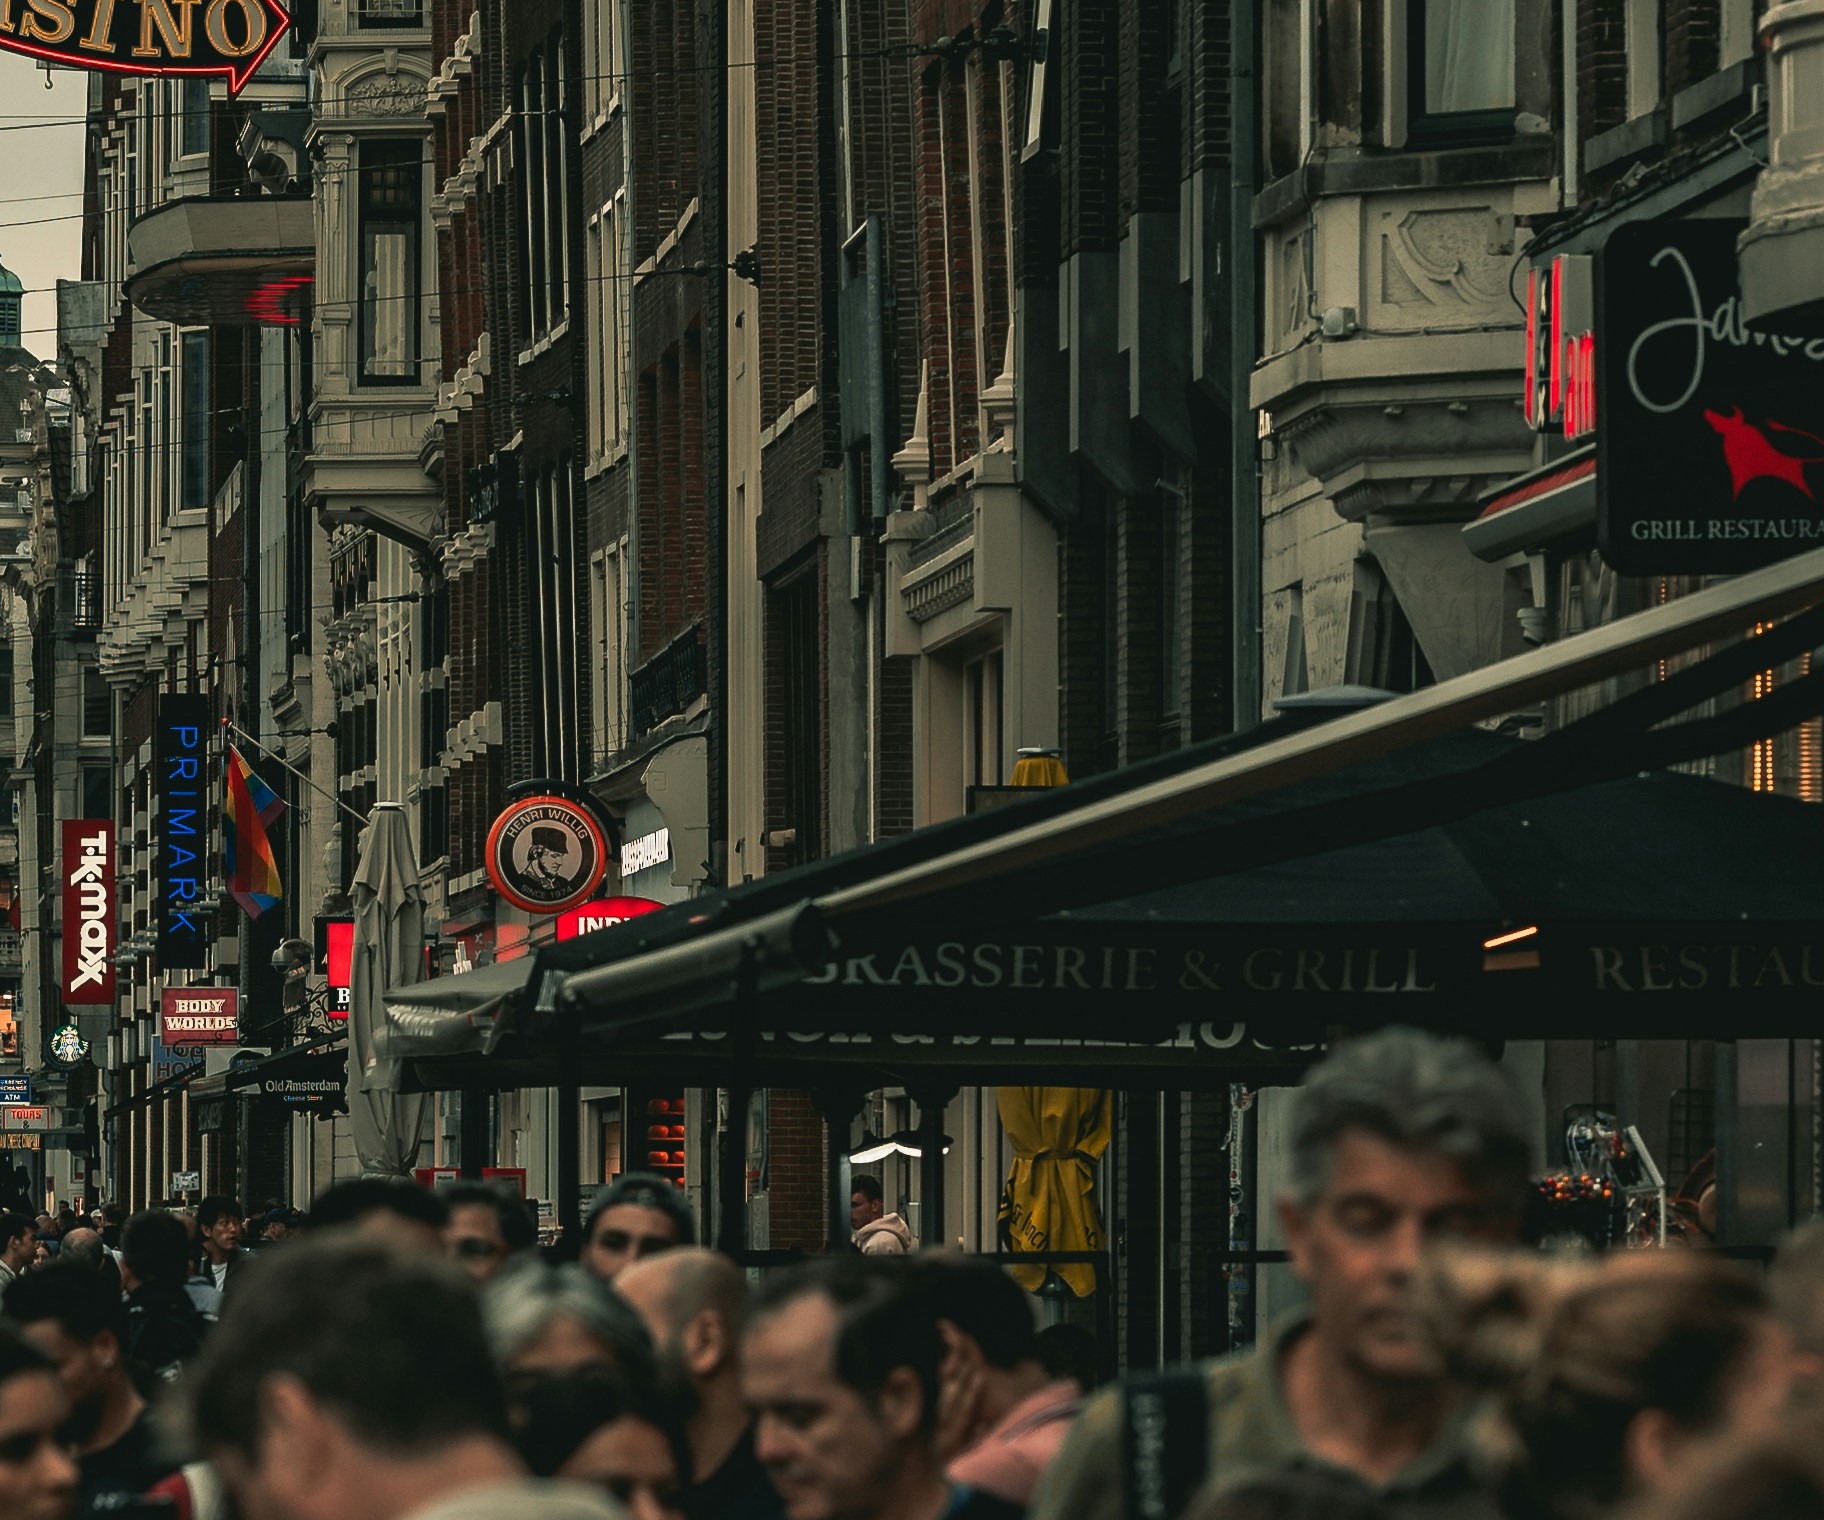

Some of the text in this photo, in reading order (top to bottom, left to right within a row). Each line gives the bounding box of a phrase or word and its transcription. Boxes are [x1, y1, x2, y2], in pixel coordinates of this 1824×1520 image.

[1631, 519, 1703, 540] GRILL
[168, 724, 199, 933] PRIMARK
[506, 807, 589, 840] HENRI WILLIG
[520, 884, 574, 899] SINCE 1974
[1177, 948, 1224, 992] &
[1242, 947, 1438, 993] GRILL
[174, 998, 227, 1015] BODY
[164, 1016, 239, 1031] WORLDS
[265, 1079, 340, 1092] Old Amsterdam
[11, 1110, 42, 1120] TOURS
